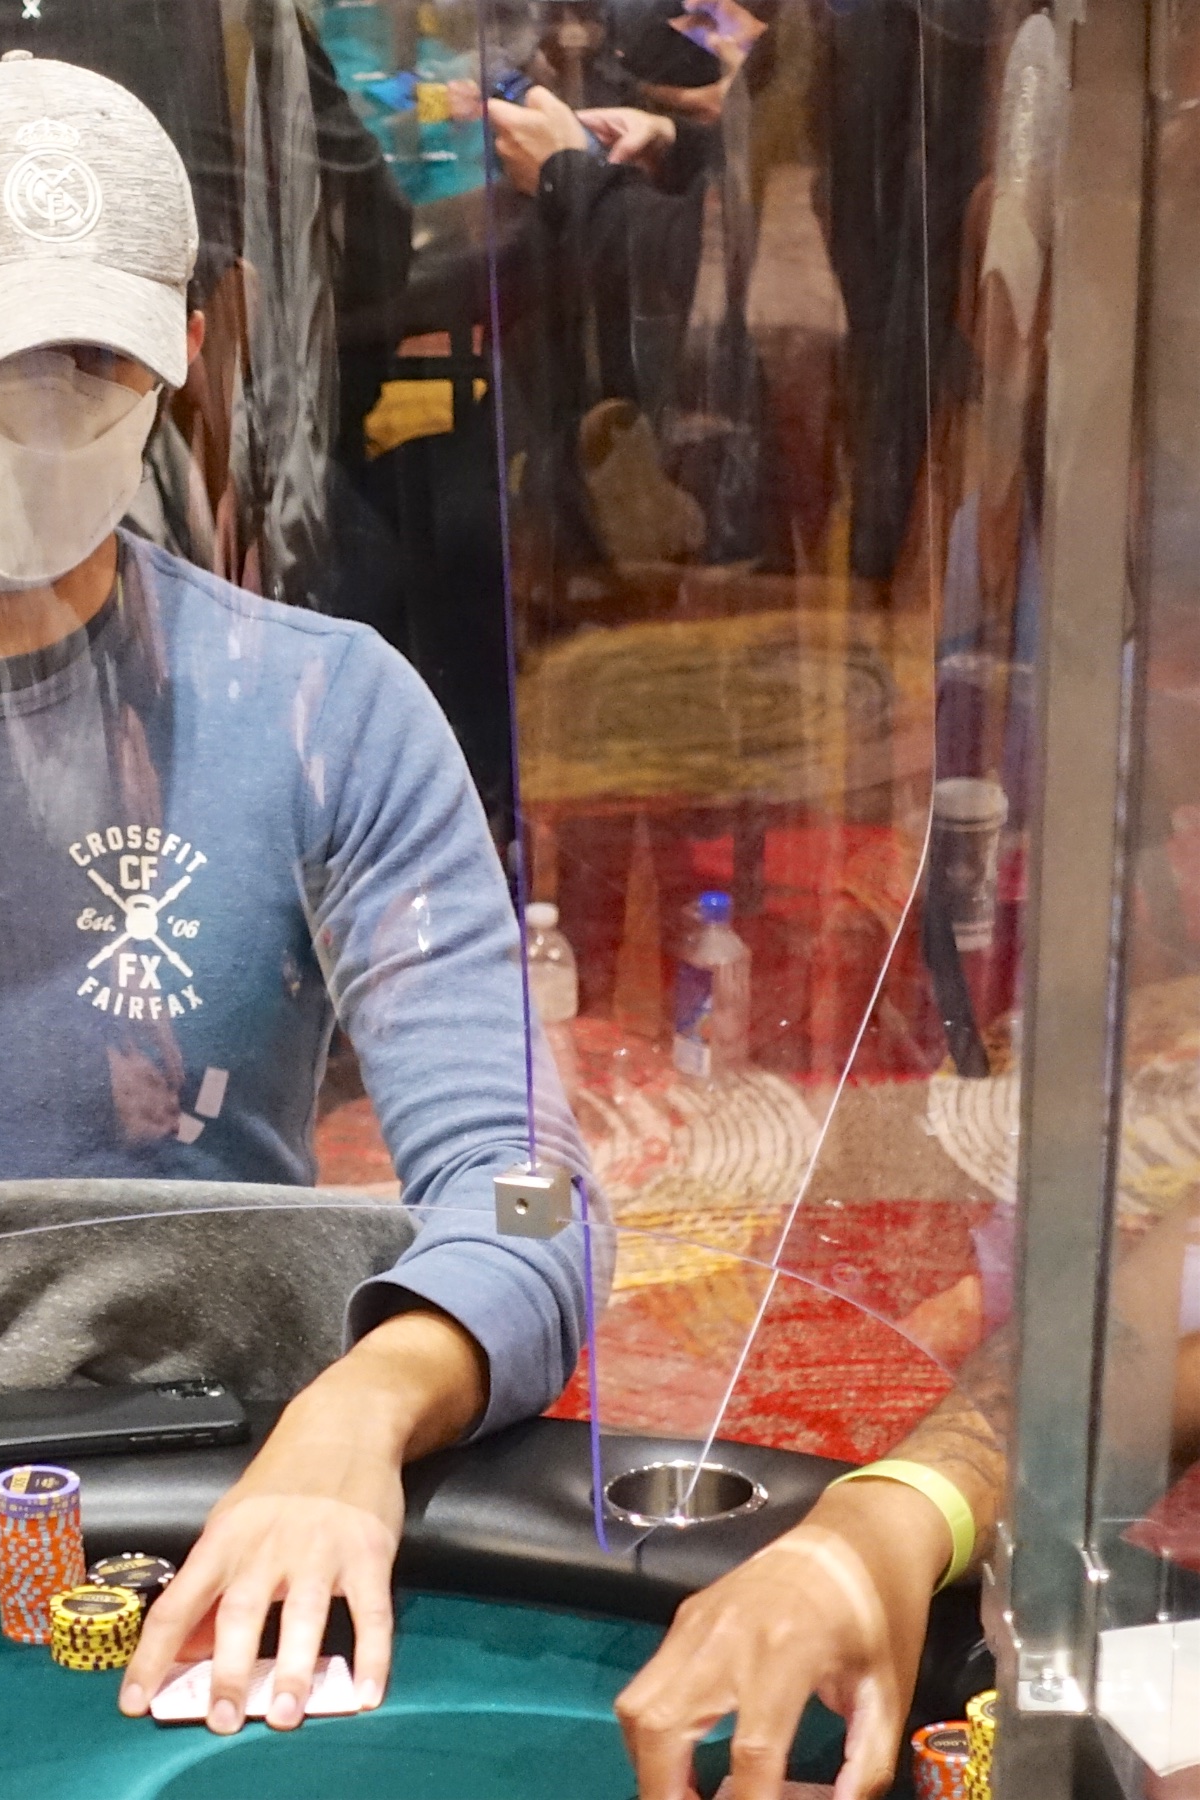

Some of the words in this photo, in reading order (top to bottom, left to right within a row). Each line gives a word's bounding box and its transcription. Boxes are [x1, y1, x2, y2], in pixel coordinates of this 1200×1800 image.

[69, 825, 207, 872] CROSSFIT
[119, 855, 158, 890] CF
[76, 908, 116, 932] Est.
[118, 953, 161, 989] FX
[77, 976, 203, 1020] FAIRFAX
